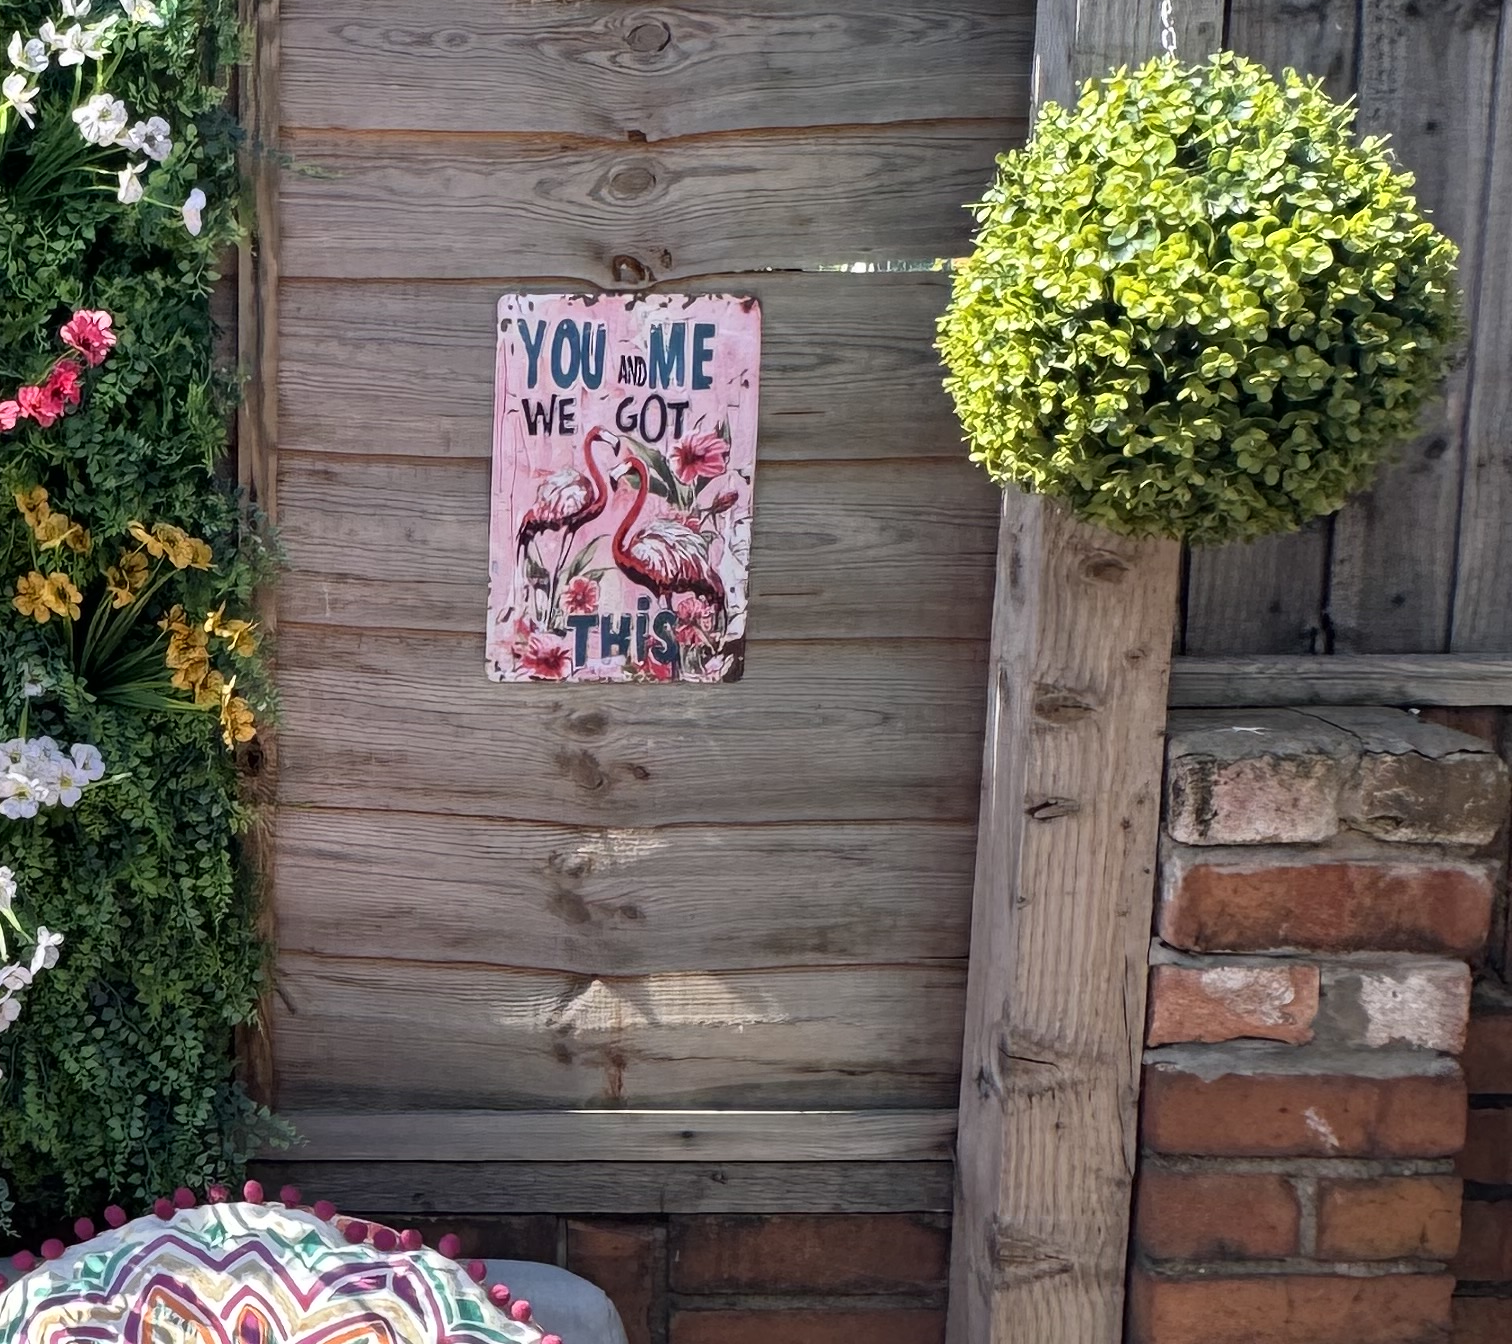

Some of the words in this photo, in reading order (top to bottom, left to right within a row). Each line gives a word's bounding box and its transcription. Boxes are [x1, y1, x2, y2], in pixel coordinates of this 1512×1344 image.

[517, 318, 607, 390] YOU
[618, 355, 648, 387] AND
[649, 323, 716, 390] ME
[522, 394, 576, 436] WE
[616, 394, 690, 443] GOT
